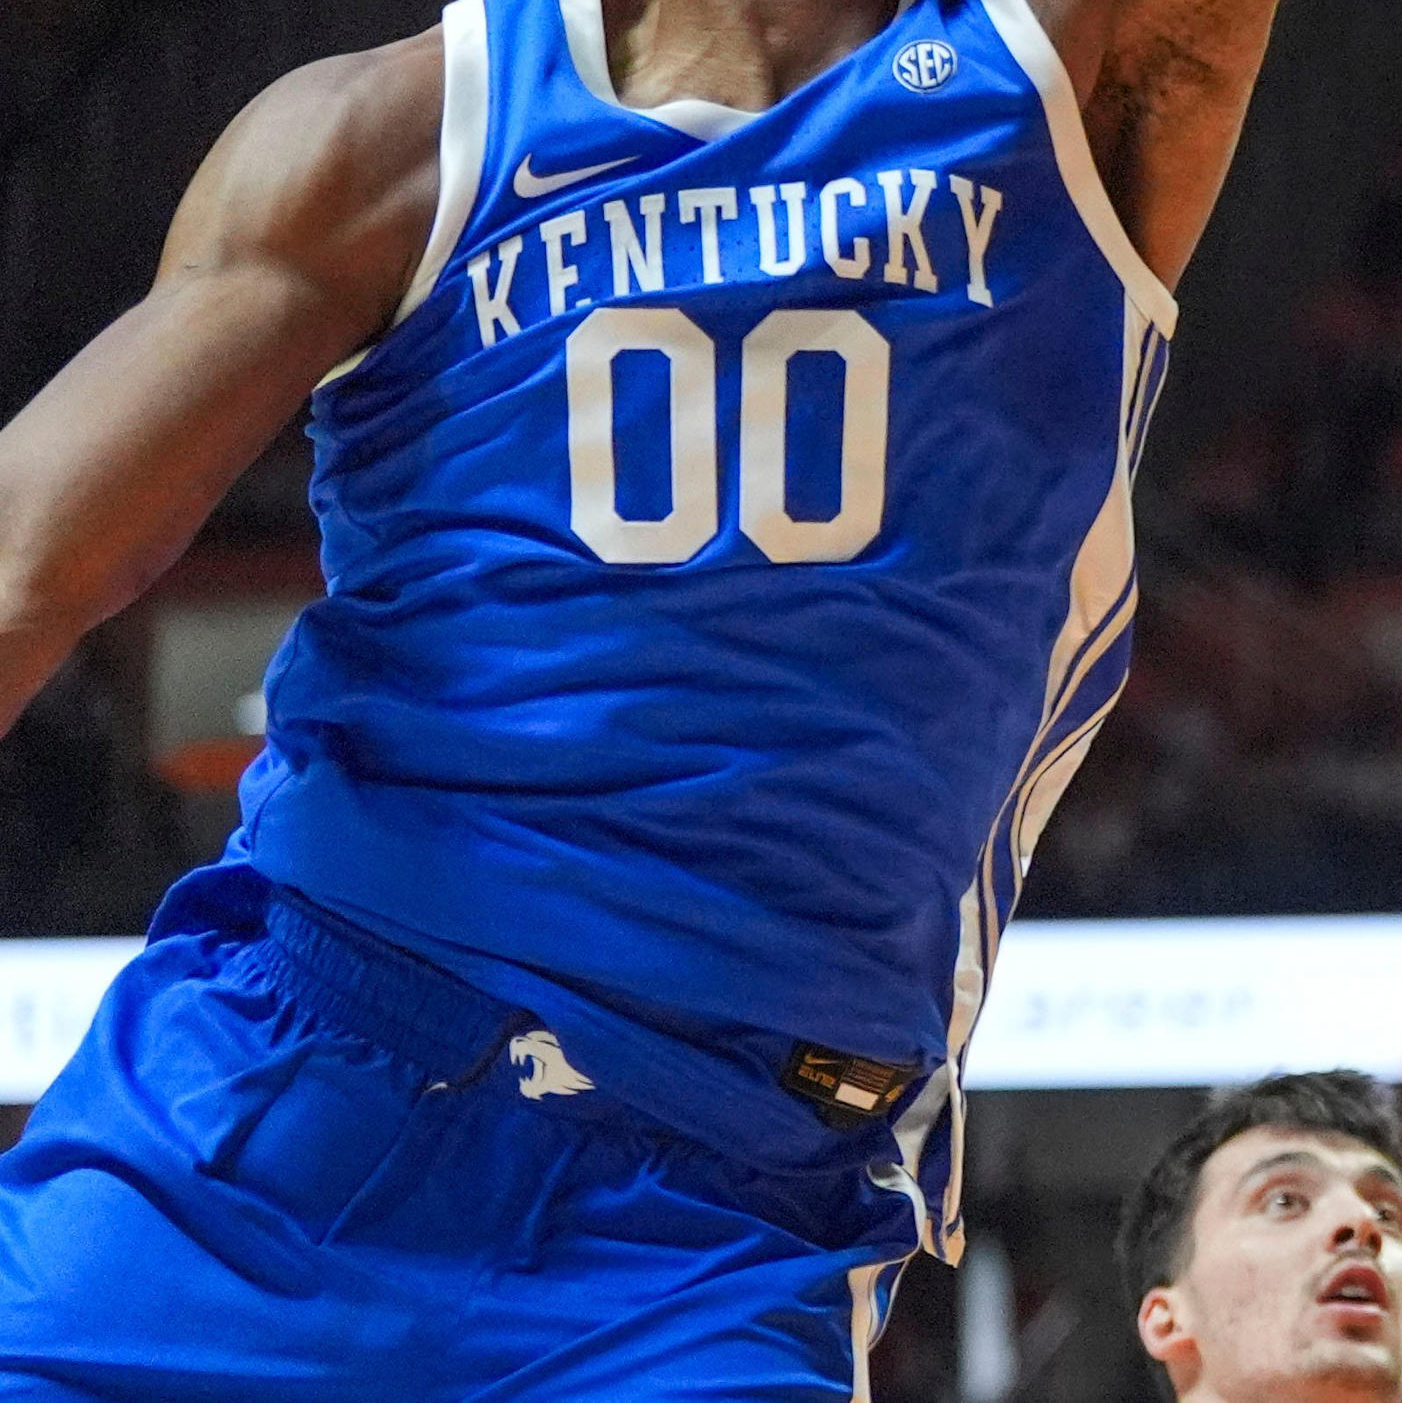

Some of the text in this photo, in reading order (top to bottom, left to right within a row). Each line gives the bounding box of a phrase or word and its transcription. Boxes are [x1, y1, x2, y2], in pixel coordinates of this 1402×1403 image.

[897, 43, 953, 88] SEC
[467, 168, 1004, 350] KENTUCKY
[565, 307, 891, 565] 00
